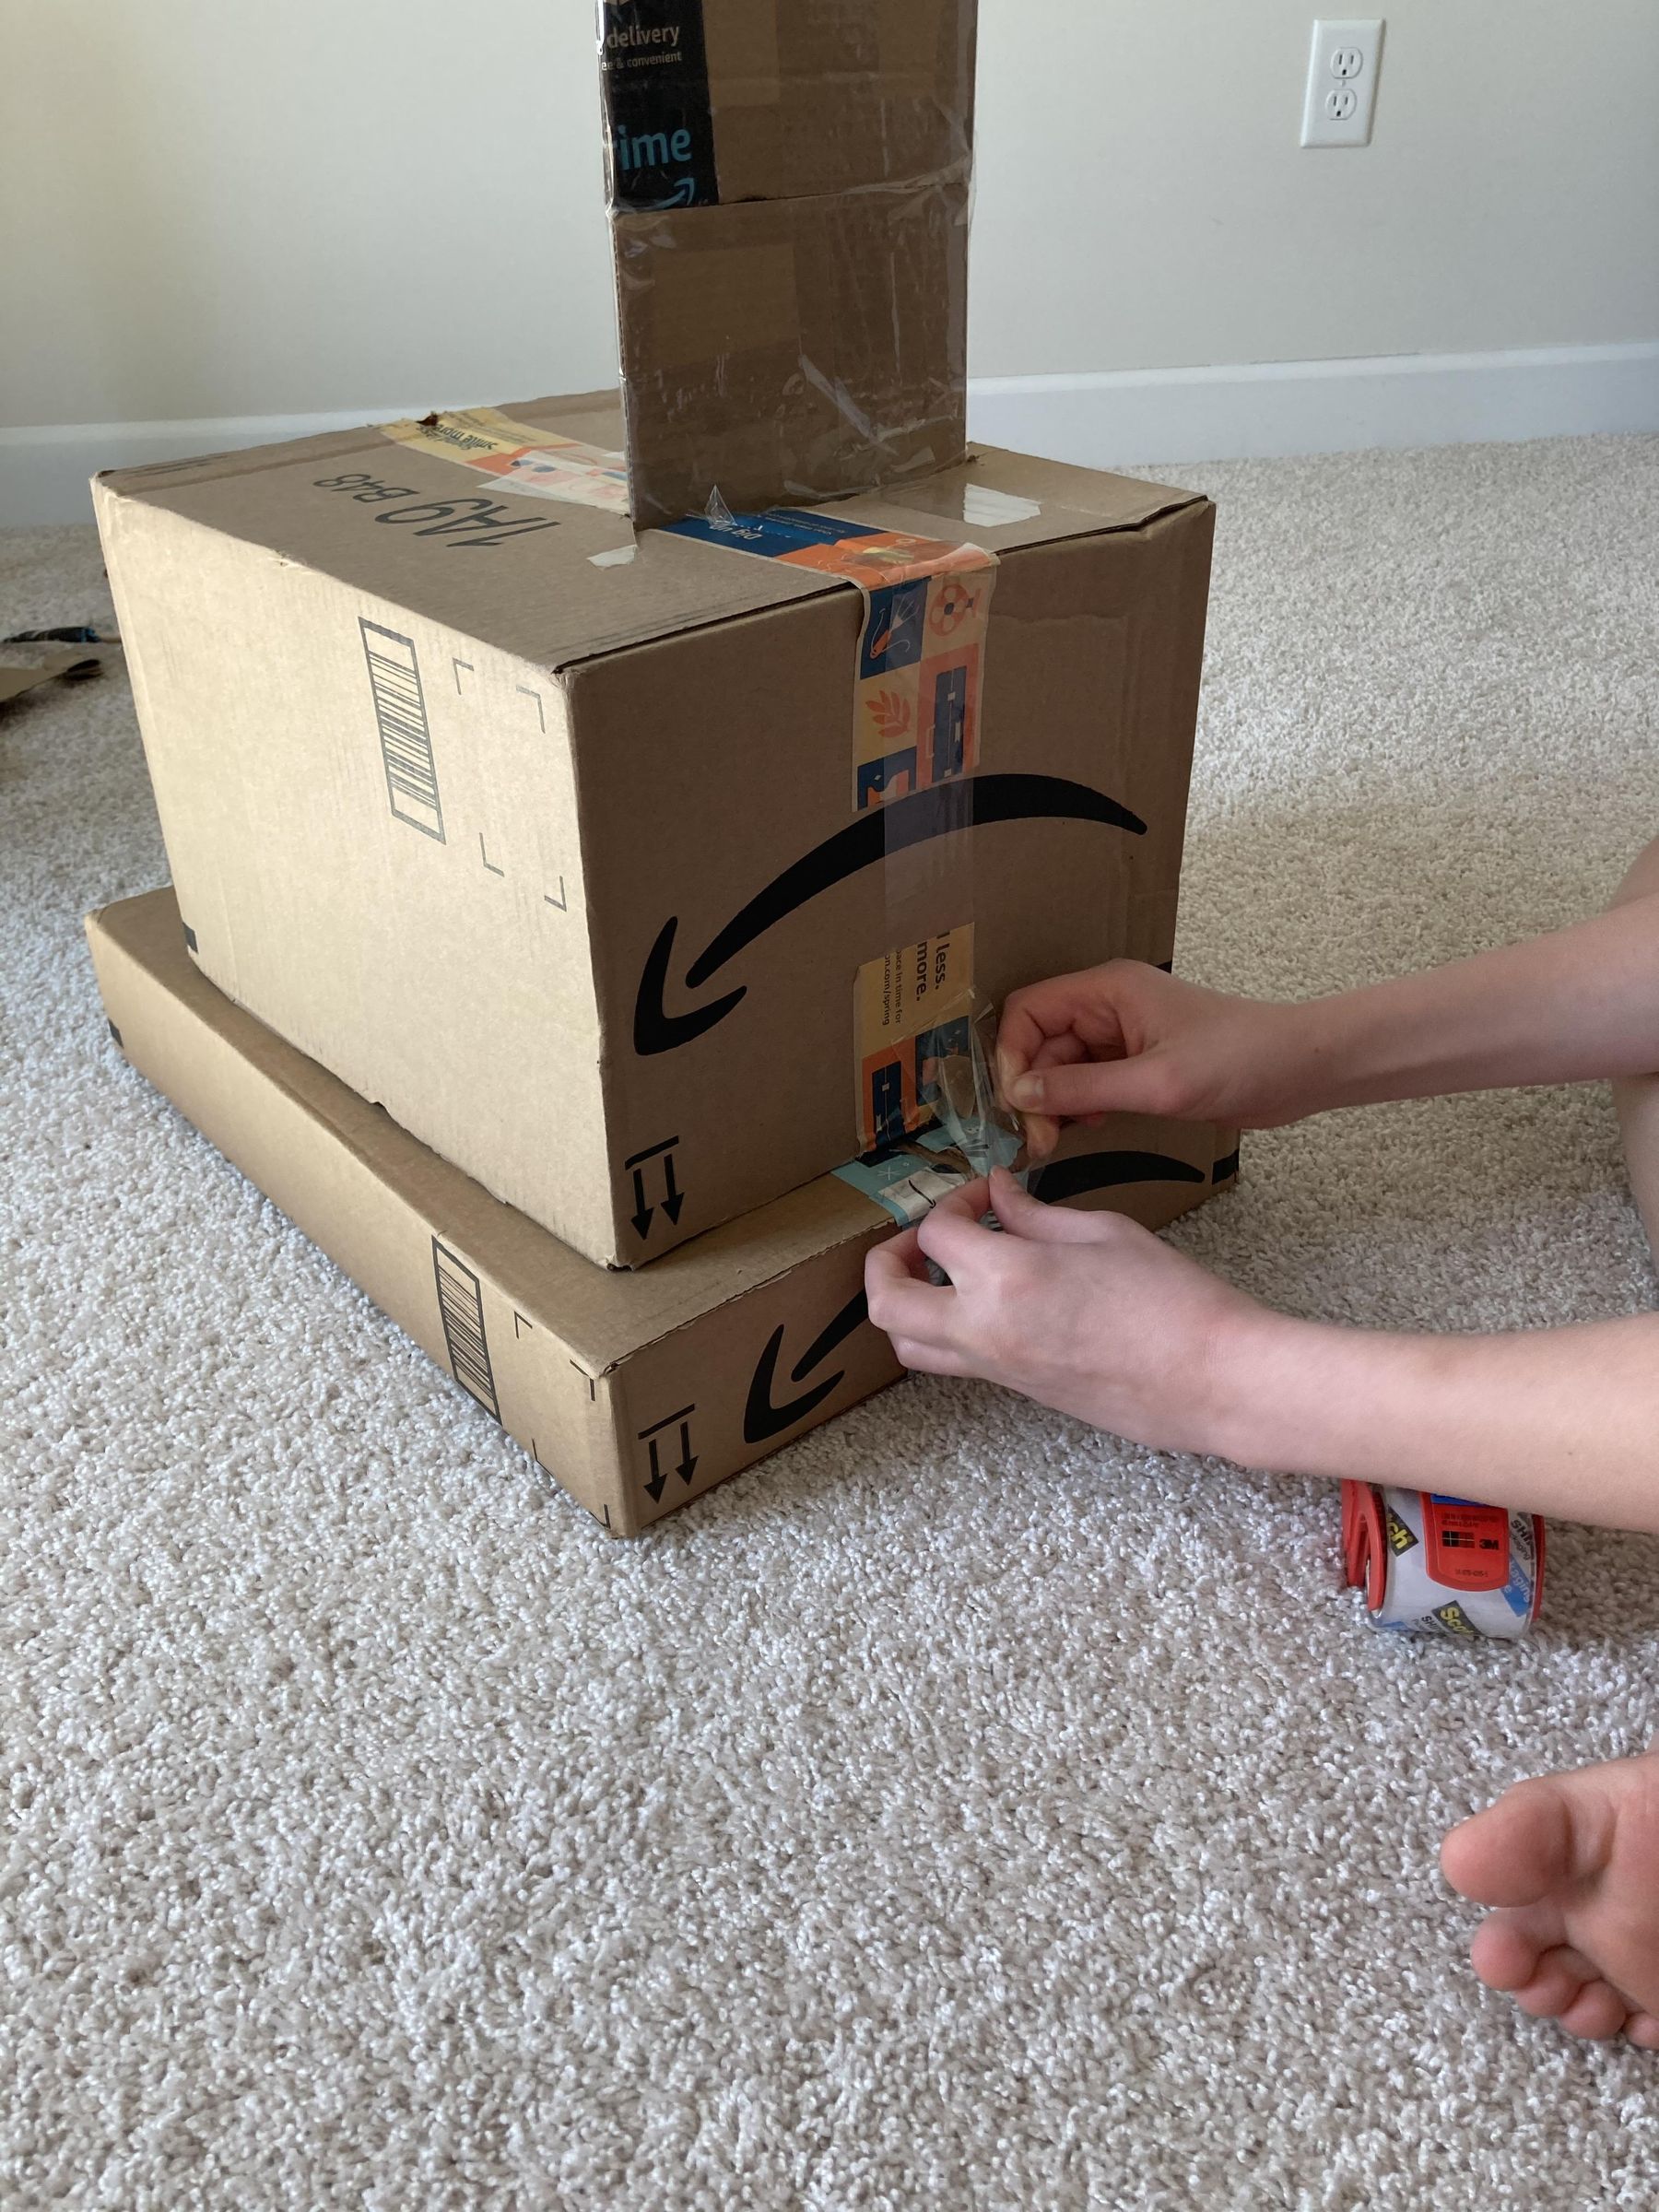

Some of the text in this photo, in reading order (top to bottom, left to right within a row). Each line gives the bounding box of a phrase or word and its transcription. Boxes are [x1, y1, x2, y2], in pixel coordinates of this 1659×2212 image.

[606, 25, 680, 49] delivery
[627, 51, 682, 68] convenient
[617, 124, 691, 171] ime
[312, 473, 560, 547] 1A9 B48
[916, 941, 927, 1002] more.
[935, 943, 950, 990] less.
[882, 955, 891, 1026] on.com/spring
[895, 1009, 903, 1024] for
[1478, 1538, 1500, 1551] 3M
